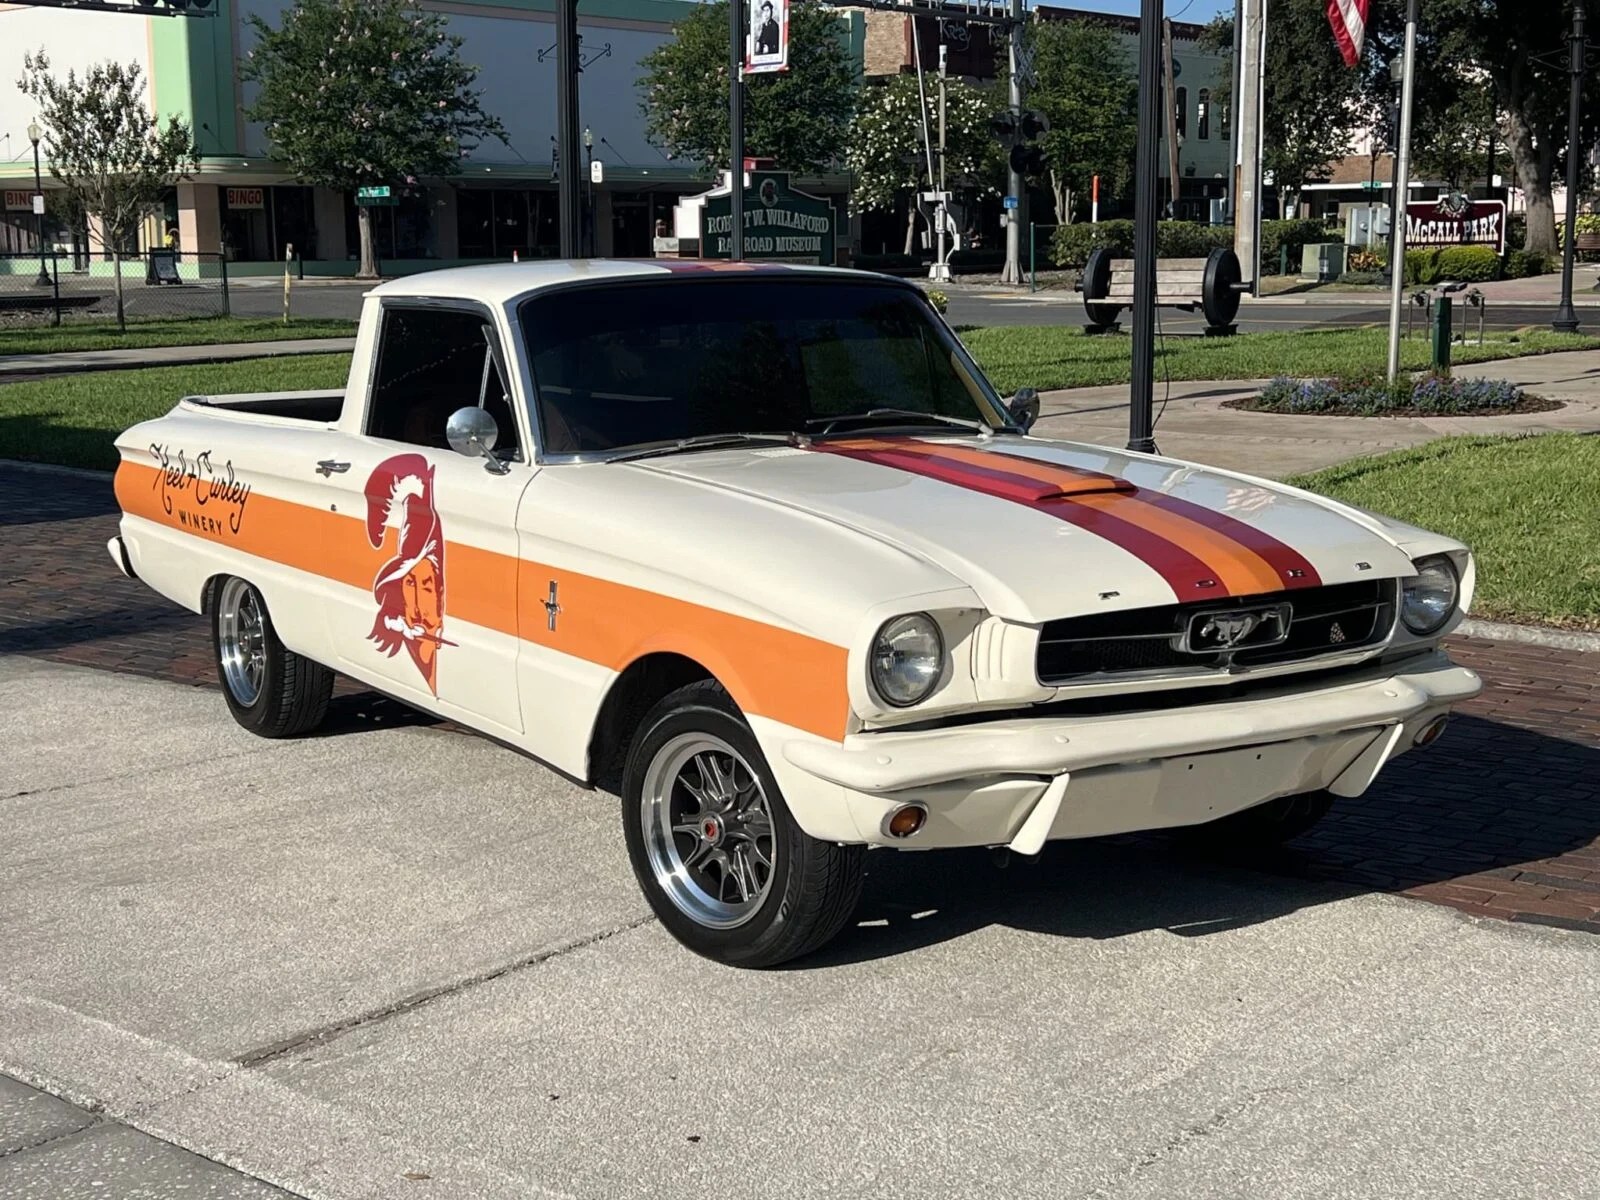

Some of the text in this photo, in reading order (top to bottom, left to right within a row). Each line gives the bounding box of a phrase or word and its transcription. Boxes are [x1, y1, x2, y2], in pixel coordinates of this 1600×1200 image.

[7, 192, 36, 205] BING
[229, 190, 262, 204] BINGO
[707, 208, 830, 234] ROBT W. WILLAFORD
[1462, 212, 1500, 241] PARK
[718, 236, 821, 253] RAROAD MUSEUM
[149, 443, 186, 516] Keel
[196, 449, 251, 535] Curley
[178, 509, 222, 536] WINERY
